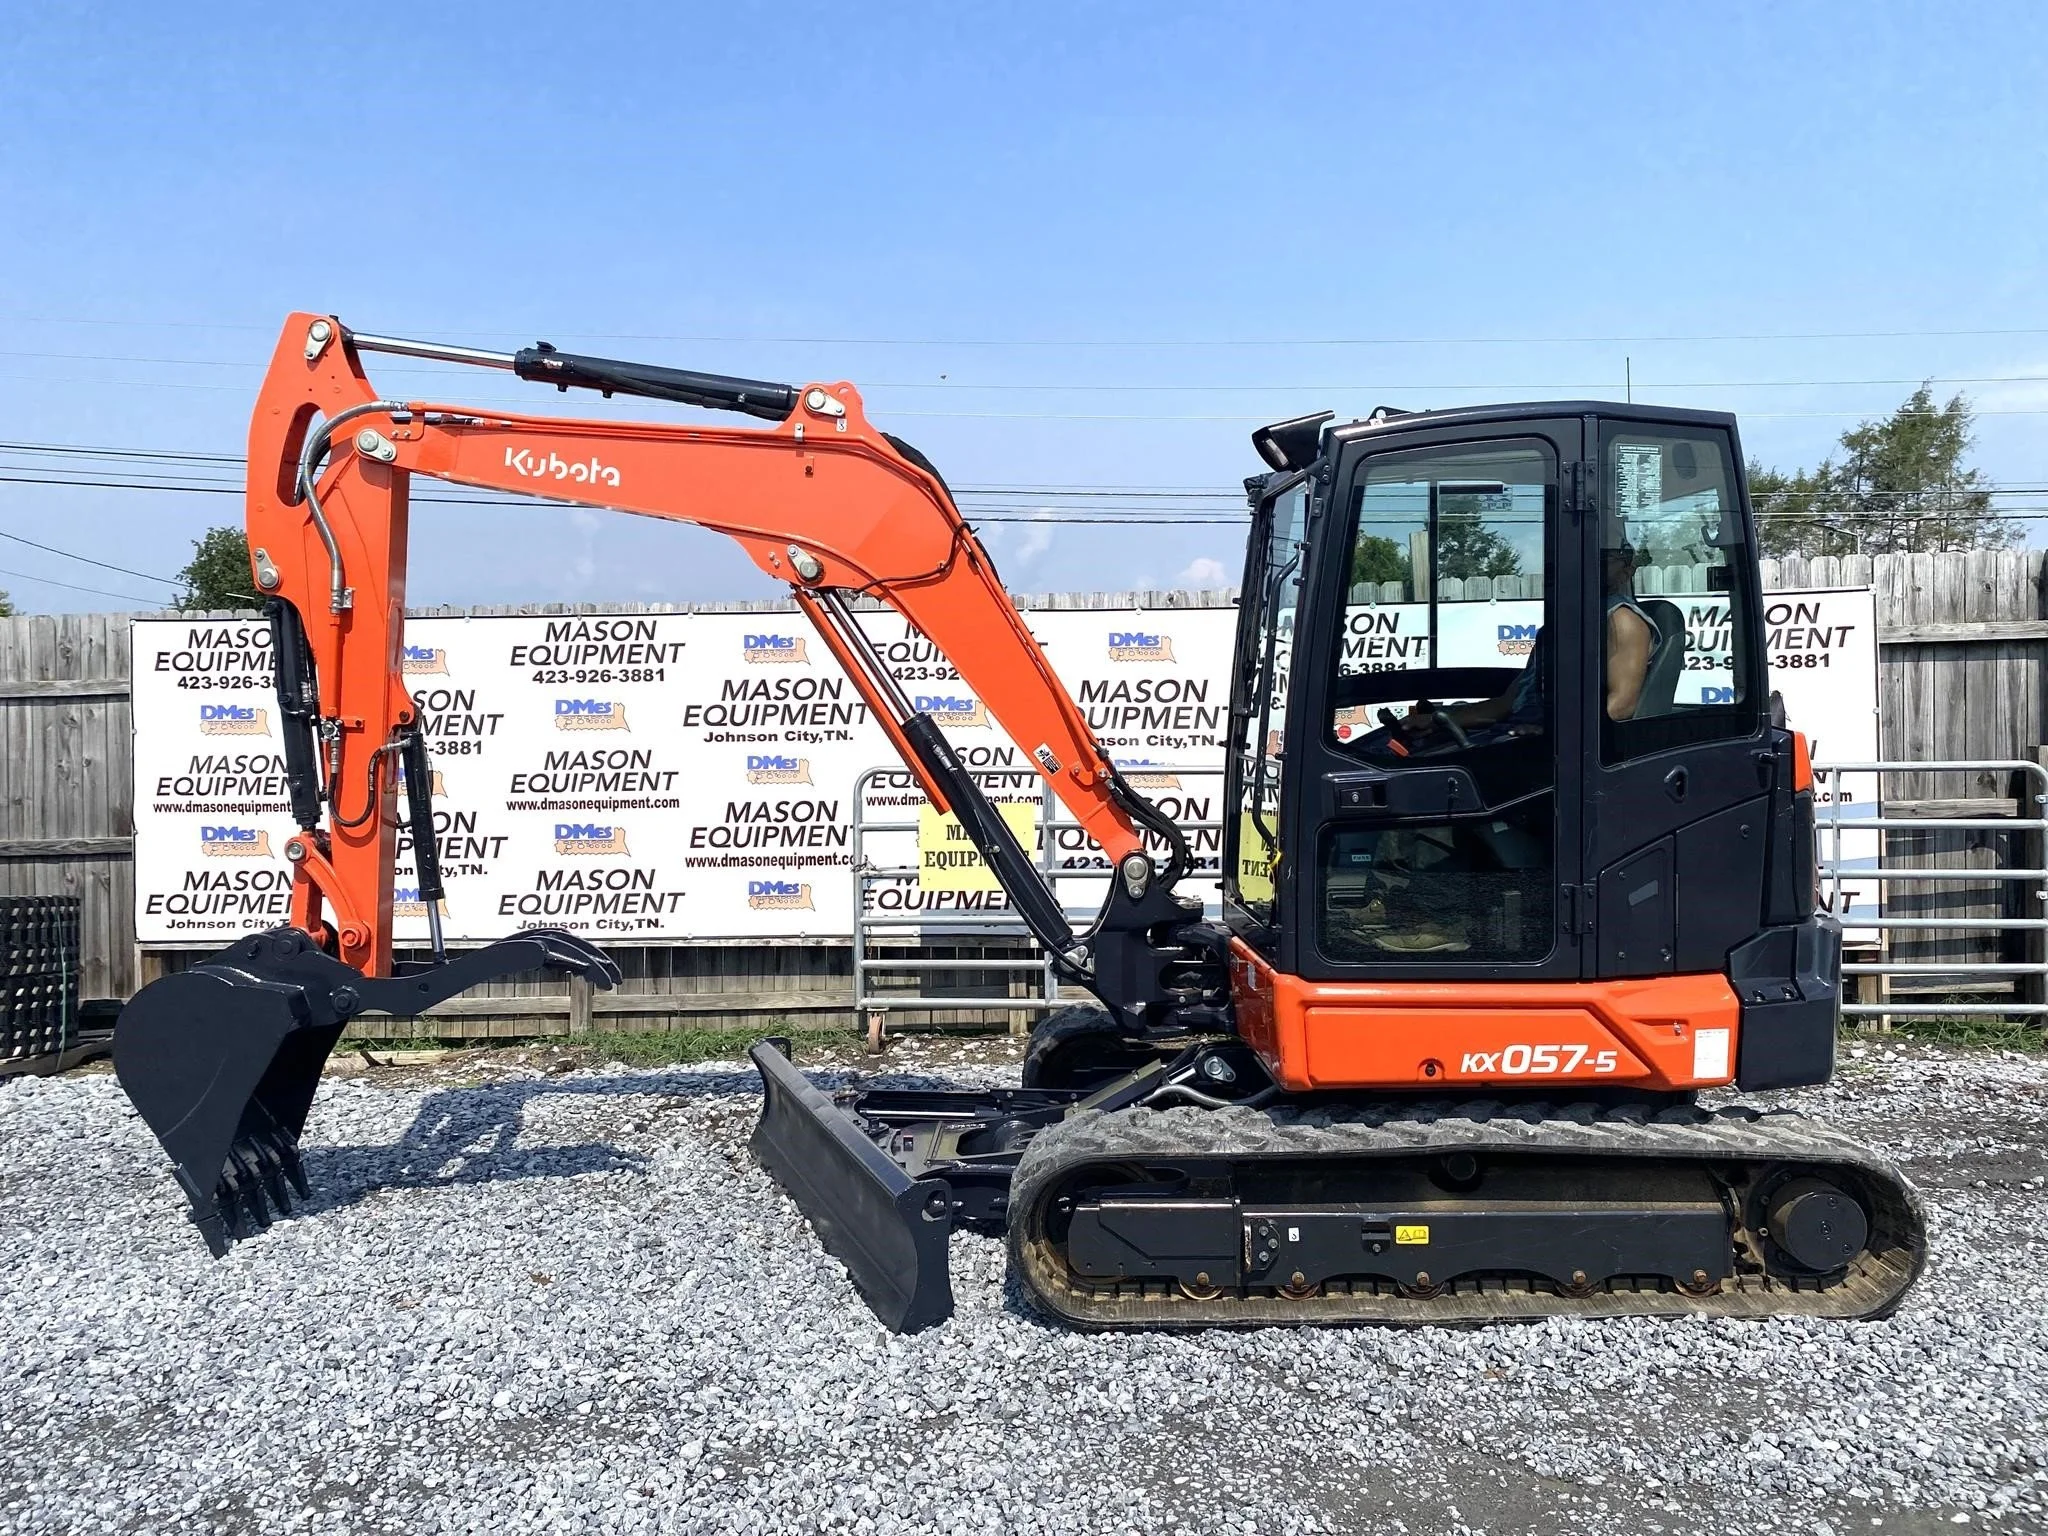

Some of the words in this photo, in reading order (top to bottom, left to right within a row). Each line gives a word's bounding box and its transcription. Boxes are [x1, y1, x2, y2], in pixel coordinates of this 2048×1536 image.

[504, 447, 620, 487] Kubota
[188, 628, 272, 649] MASO
[545, 620, 657, 642] MASON
[510, 643, 686, 666] EQUIPMENT
[532, 668, 665, 684] 423-926-3881
[413, 689, 475, 711] SON
[721, 678, 843, 701] MASON
[1079, 679, 1209, 703] MASON
[683, 703, 868, 727] EQUIPMENT
[704, 732, 778, 743] Johnson
[784, 730, 854, 744] City,TN.
[1146, 735, 1215, 748] City,TN
[544, 750, 652, 770] MASON
[510, 771, 679, 793] EQUIPMENT
[153, 800, 292, 815] www.dmasonequipment
[506, 797, 680, 812] www.dmasonequipment.com
[725, 800, 838, 823] MASON
[690, 825, 853, 848] EQUIPMEN
[536, 869, 655, 891] MASON
[498, 892, 686, 915] EQUIPMENT
[166, 919, 236, 929] Johnson
[596, 918, 665, 931] City,TN.
[1460, 1044, 1618, 1074] KX057-5
